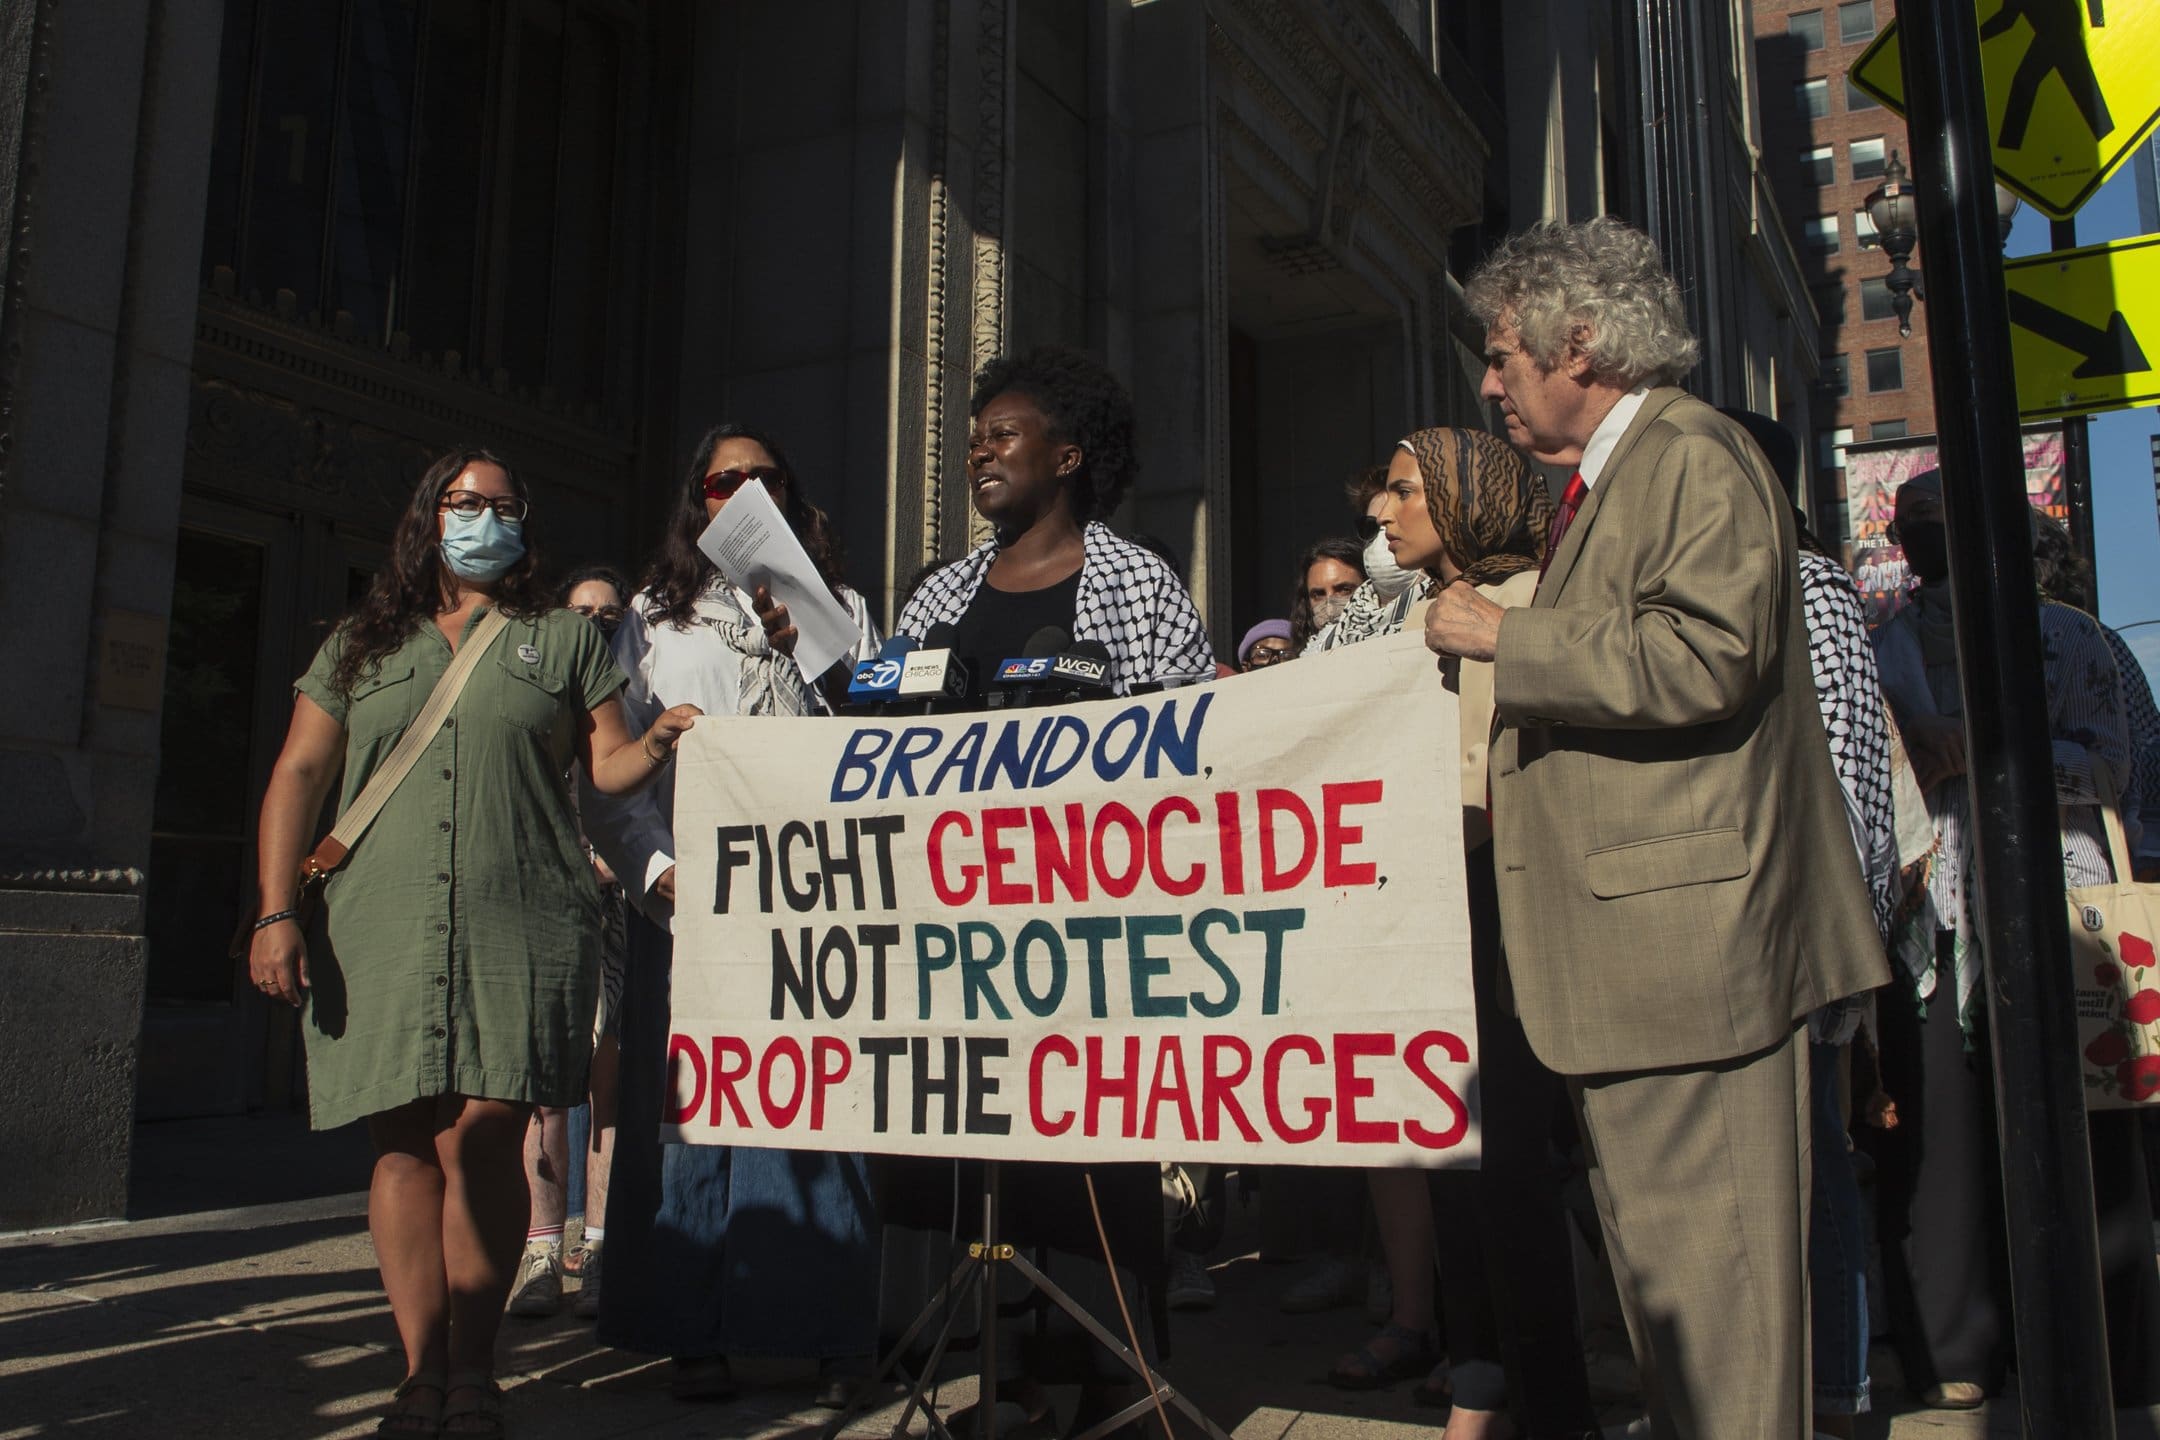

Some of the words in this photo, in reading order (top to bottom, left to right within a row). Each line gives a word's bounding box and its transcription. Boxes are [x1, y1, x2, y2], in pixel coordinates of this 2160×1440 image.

[1859, 540, 1877, 549] THE
[856, 670, 875, 680] abc
[867, 660, 901, 688] 7
[904, 669, 943, 678] CHICAGO
[1027, 658, 1049, 674] 5
[1058, 656, 1105, 677] WGN
[831, 692, 1213, 802] BRANDON,
[713, 815, 905, 914] FIGHT
[927, 780, 1388, 907] GENOCIDE,
[770, 925, 900, 1021] NOT
[916, 908, 1306, 1021] PROTEST
[663, 1034, 853, 1132] DROP
[858, 1036, 1012, 1135] THE
[1028, 1030, 1470, 1150] CHARGES
